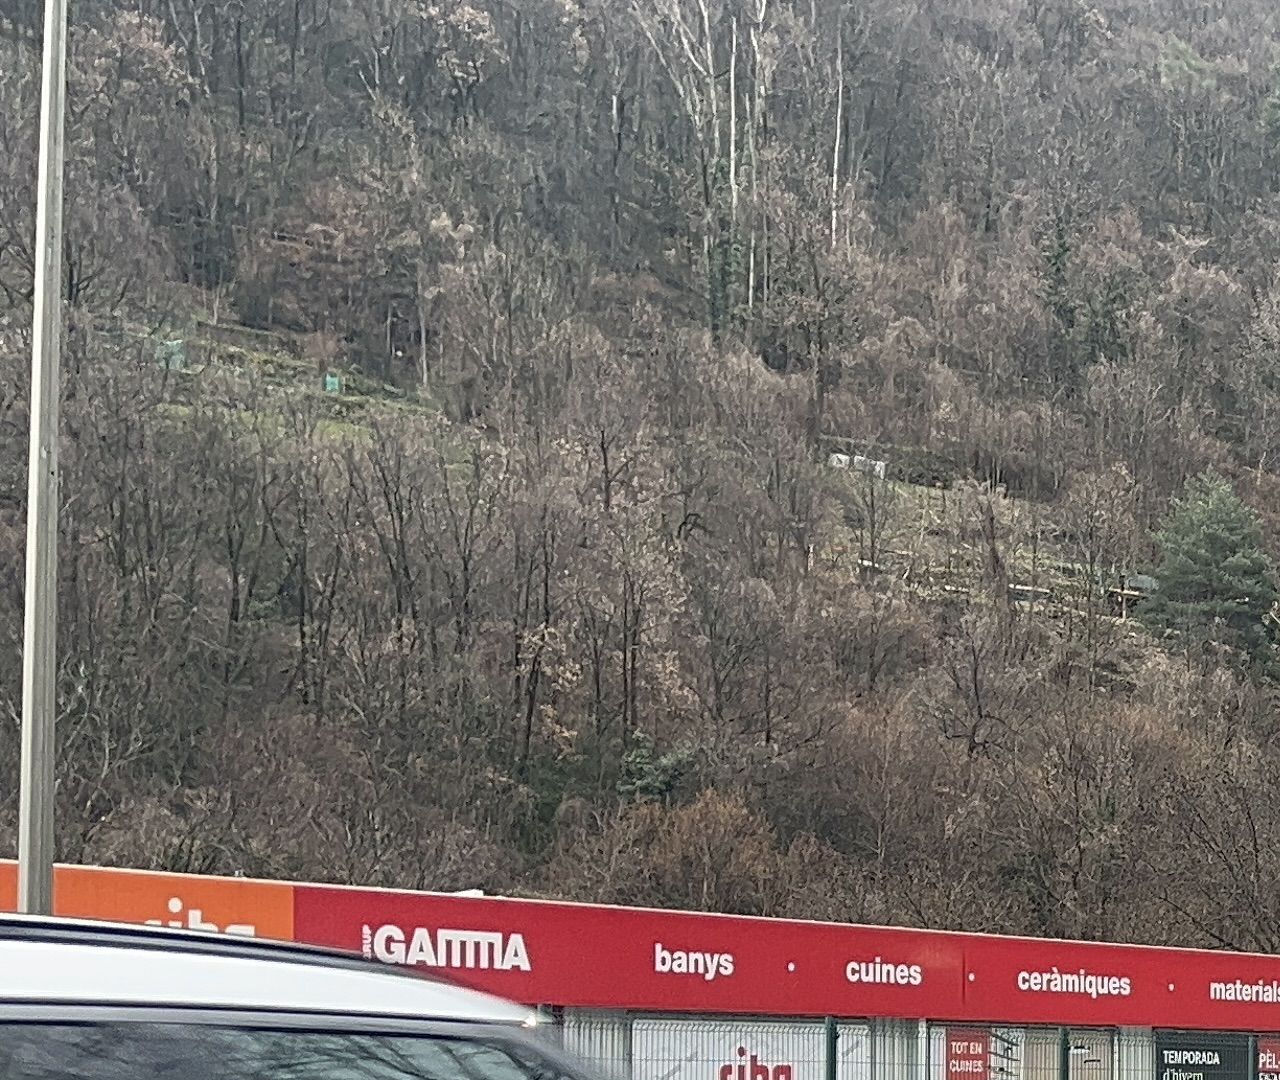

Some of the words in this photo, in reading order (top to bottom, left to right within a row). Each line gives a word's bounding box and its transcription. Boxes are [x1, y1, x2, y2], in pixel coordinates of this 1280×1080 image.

[654, 942, 735, 981] banys
[846, 956, 923, 986] cuines
[1017, 966, 1132, 999] ceràmiques
[1162, 1050, 1221, 1065] TEMPORADA
